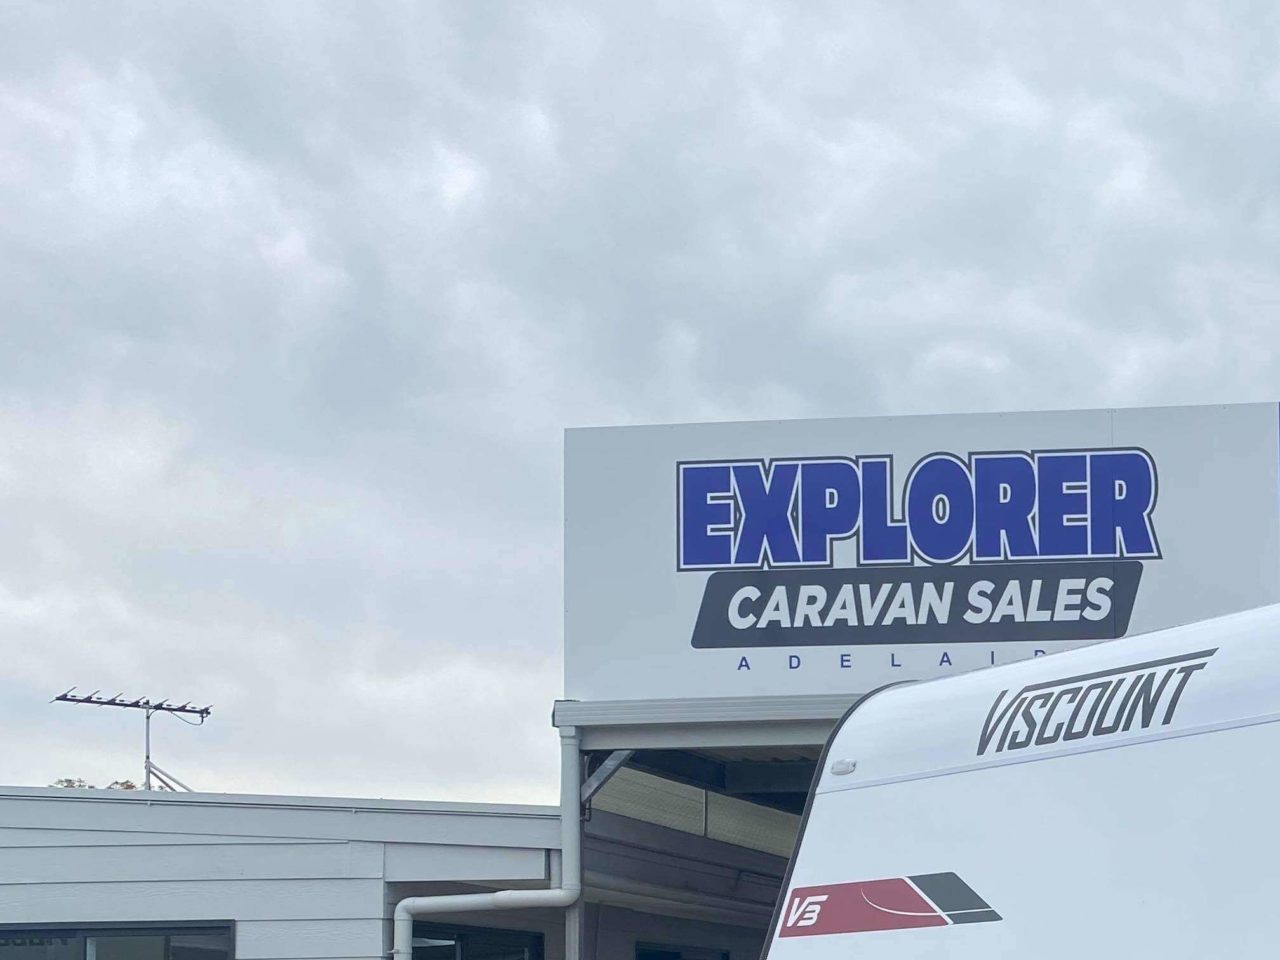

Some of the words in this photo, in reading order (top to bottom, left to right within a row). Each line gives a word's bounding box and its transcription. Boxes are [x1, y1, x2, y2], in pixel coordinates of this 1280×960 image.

[677, 447, 1162, 572] EXPLORER
[727, 582, 952, 630] CARAVAN
[963, 577, 1114, 625] SALES
[976, 648, 1220, 756] VISCOUNT
[787, 894, 829, 928] V3
